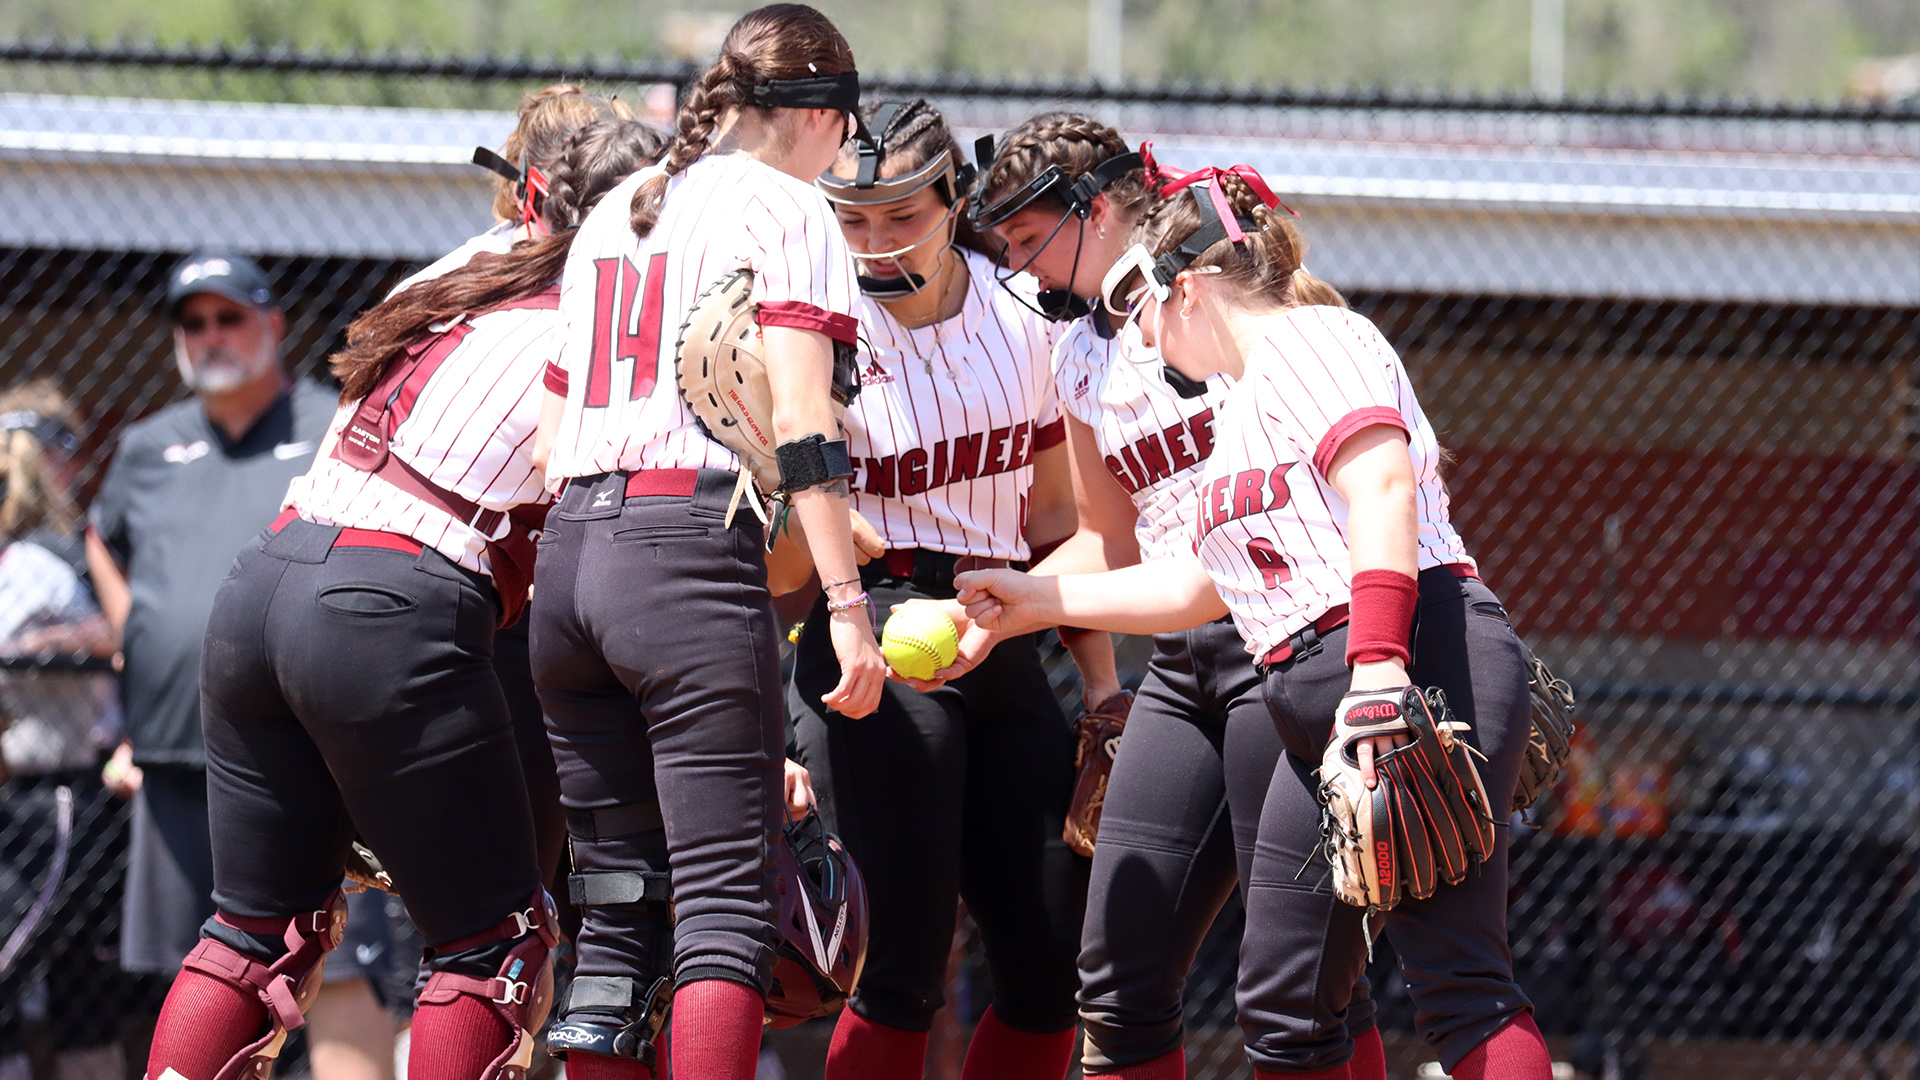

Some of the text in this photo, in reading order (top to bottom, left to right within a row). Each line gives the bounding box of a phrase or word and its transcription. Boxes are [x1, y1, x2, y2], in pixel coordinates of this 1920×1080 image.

[584, 252, 668, 409] 14
[351, 425, 380, 444] EASTON
[728, 389, 739, 401] THE
[737, 400, 749, 416] GOLD
[747, 416, 762, 437] GLOVE
[848, 419, 1036, 499] ENGINEE
[1346, 702, 1398, 724] Wilson
[1376, 841, 1392, 887] A2000
